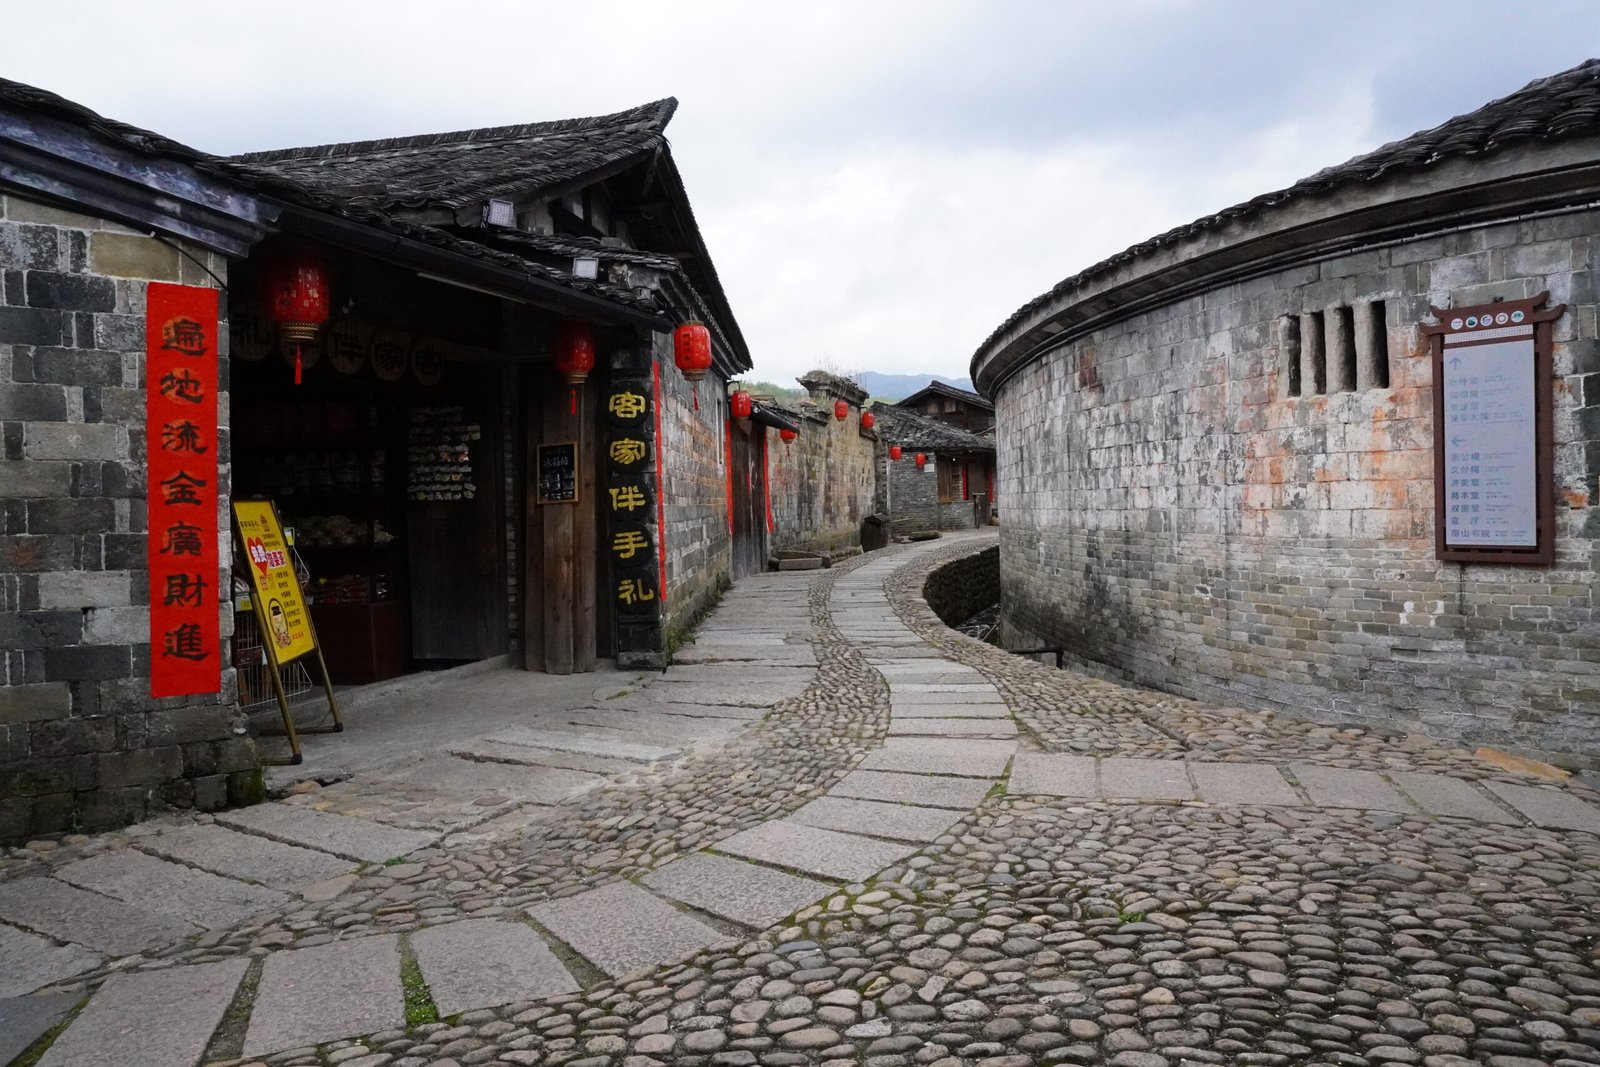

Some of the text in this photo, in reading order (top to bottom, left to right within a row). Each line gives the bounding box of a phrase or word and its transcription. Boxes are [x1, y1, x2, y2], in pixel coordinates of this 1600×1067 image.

[159, 318, 210, 663] 遍地流金廣財進
[608, 391, 655, 605] 客家伴手礼
